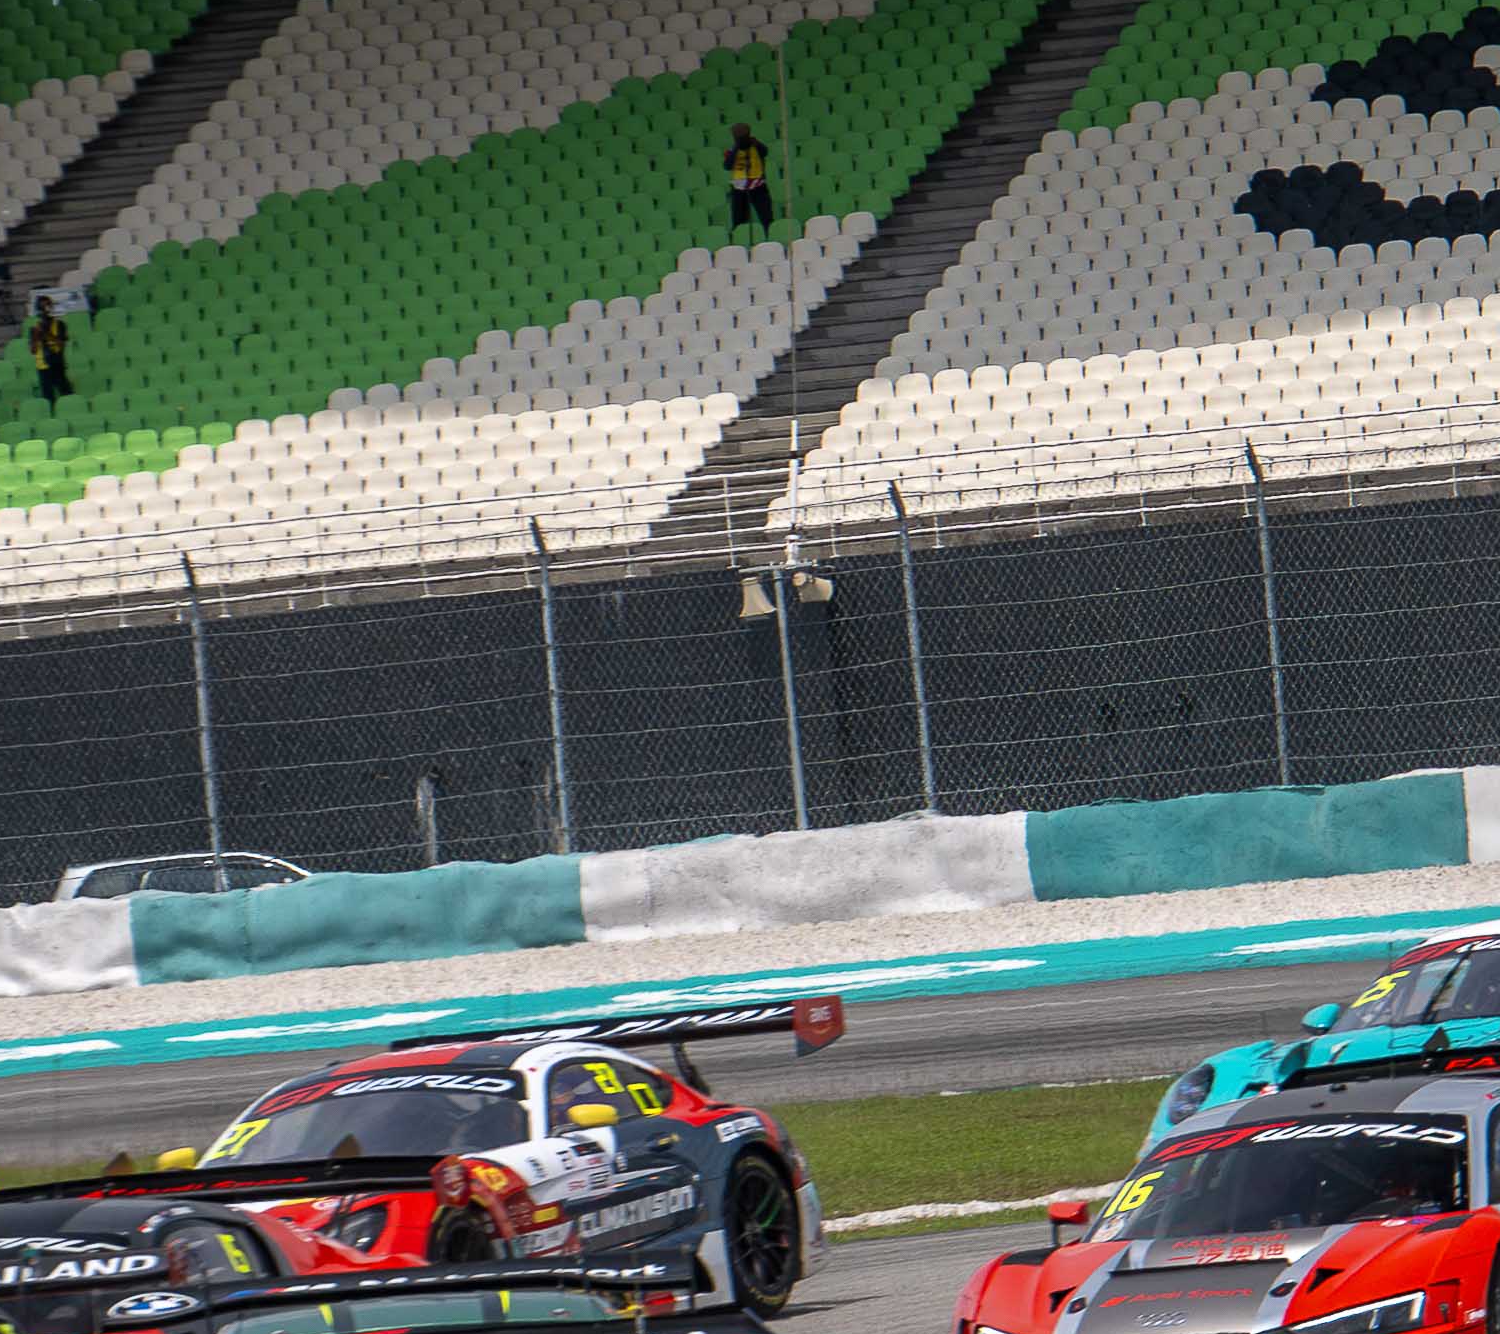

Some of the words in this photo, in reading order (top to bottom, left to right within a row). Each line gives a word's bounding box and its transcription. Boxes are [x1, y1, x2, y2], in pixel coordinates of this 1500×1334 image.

[332, 1073, 517, 1095] WORLD
[1250, 1122, 1467, 1145] WORLD
[1103, 1170, 1164, 1217] 16
